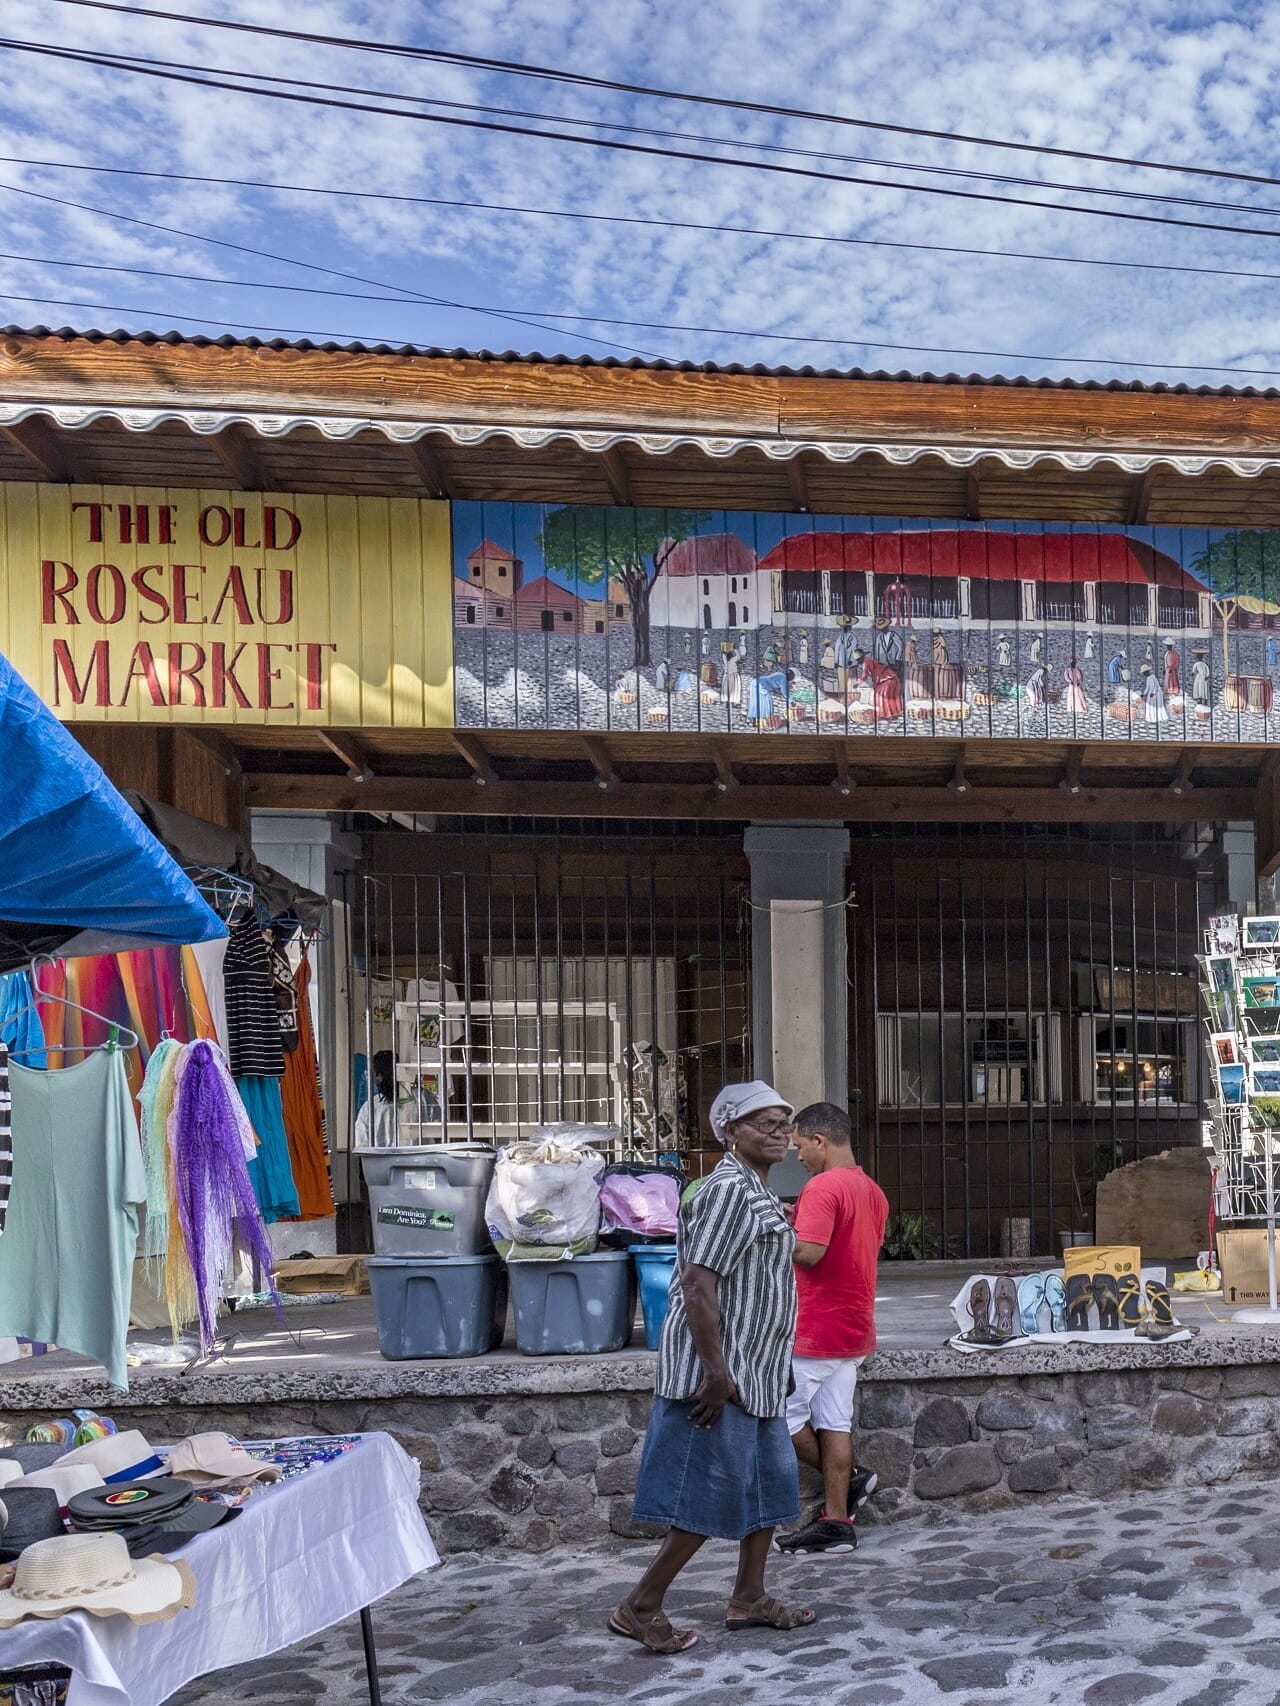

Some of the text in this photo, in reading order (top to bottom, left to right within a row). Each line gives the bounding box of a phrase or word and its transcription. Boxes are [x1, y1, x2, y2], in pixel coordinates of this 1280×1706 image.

[72, 502, 303, 551] THE OLD
[41, 560, 294, 626] ROSEAU
[52, 638, 337, 711] MARKET
[393, 1208, 426, 1218] Dominica.
[397, 1216, 410, 1224] Are
[410, 1217, 427, 1226] You?
